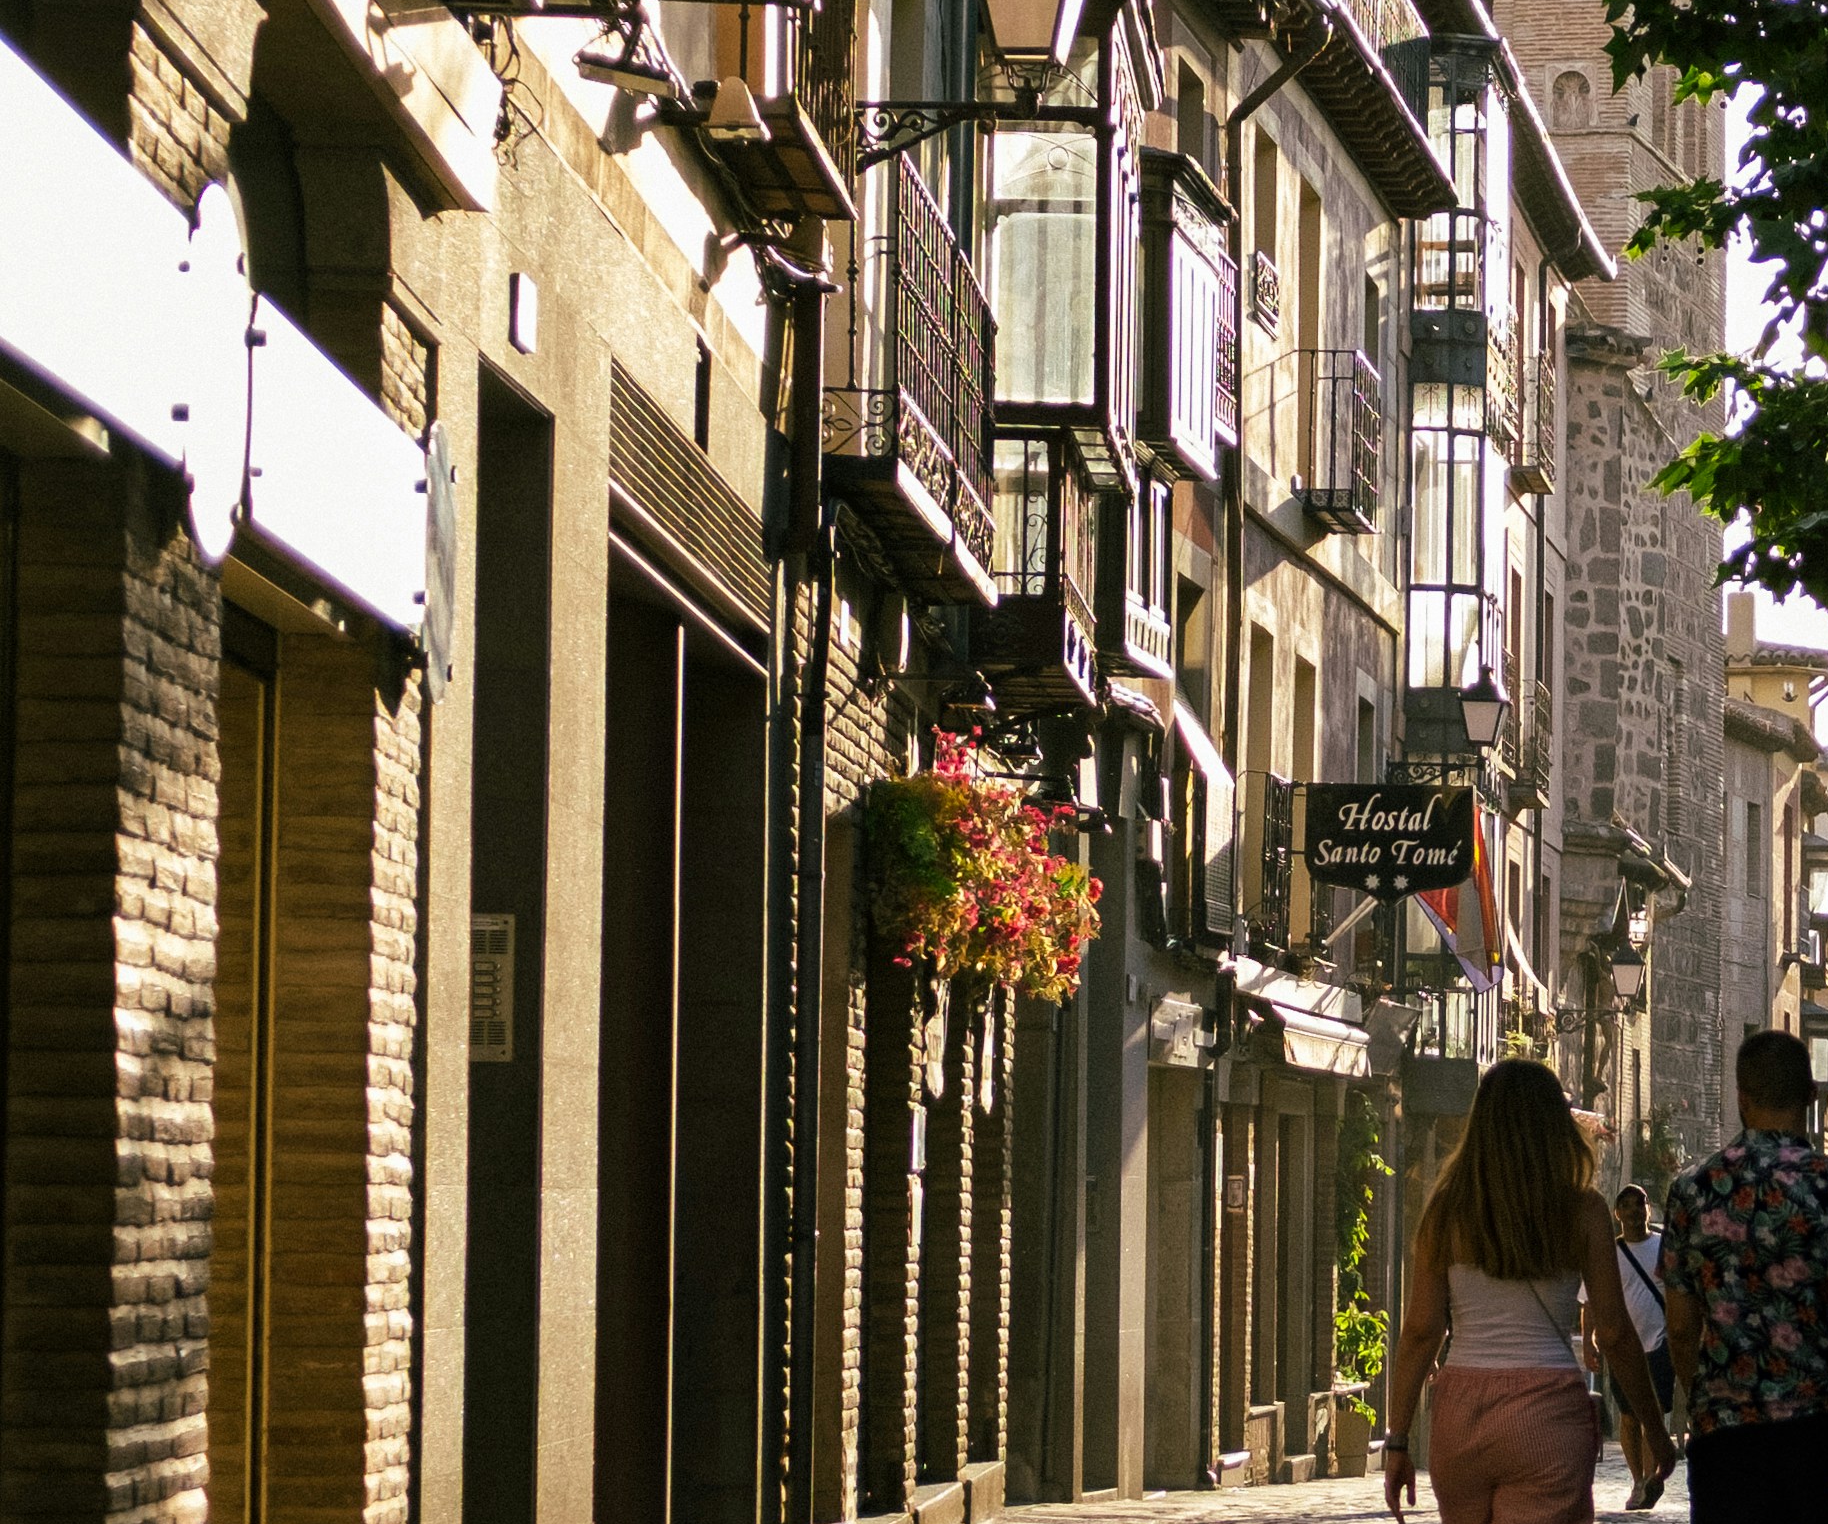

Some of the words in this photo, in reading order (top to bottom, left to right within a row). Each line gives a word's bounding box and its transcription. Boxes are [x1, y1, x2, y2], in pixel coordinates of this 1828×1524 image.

[1338, 793, 1443, 832] Hostal
[1314, 839, 1381, 866] Santo
[1391, 839, 1462, 866] Tomé
